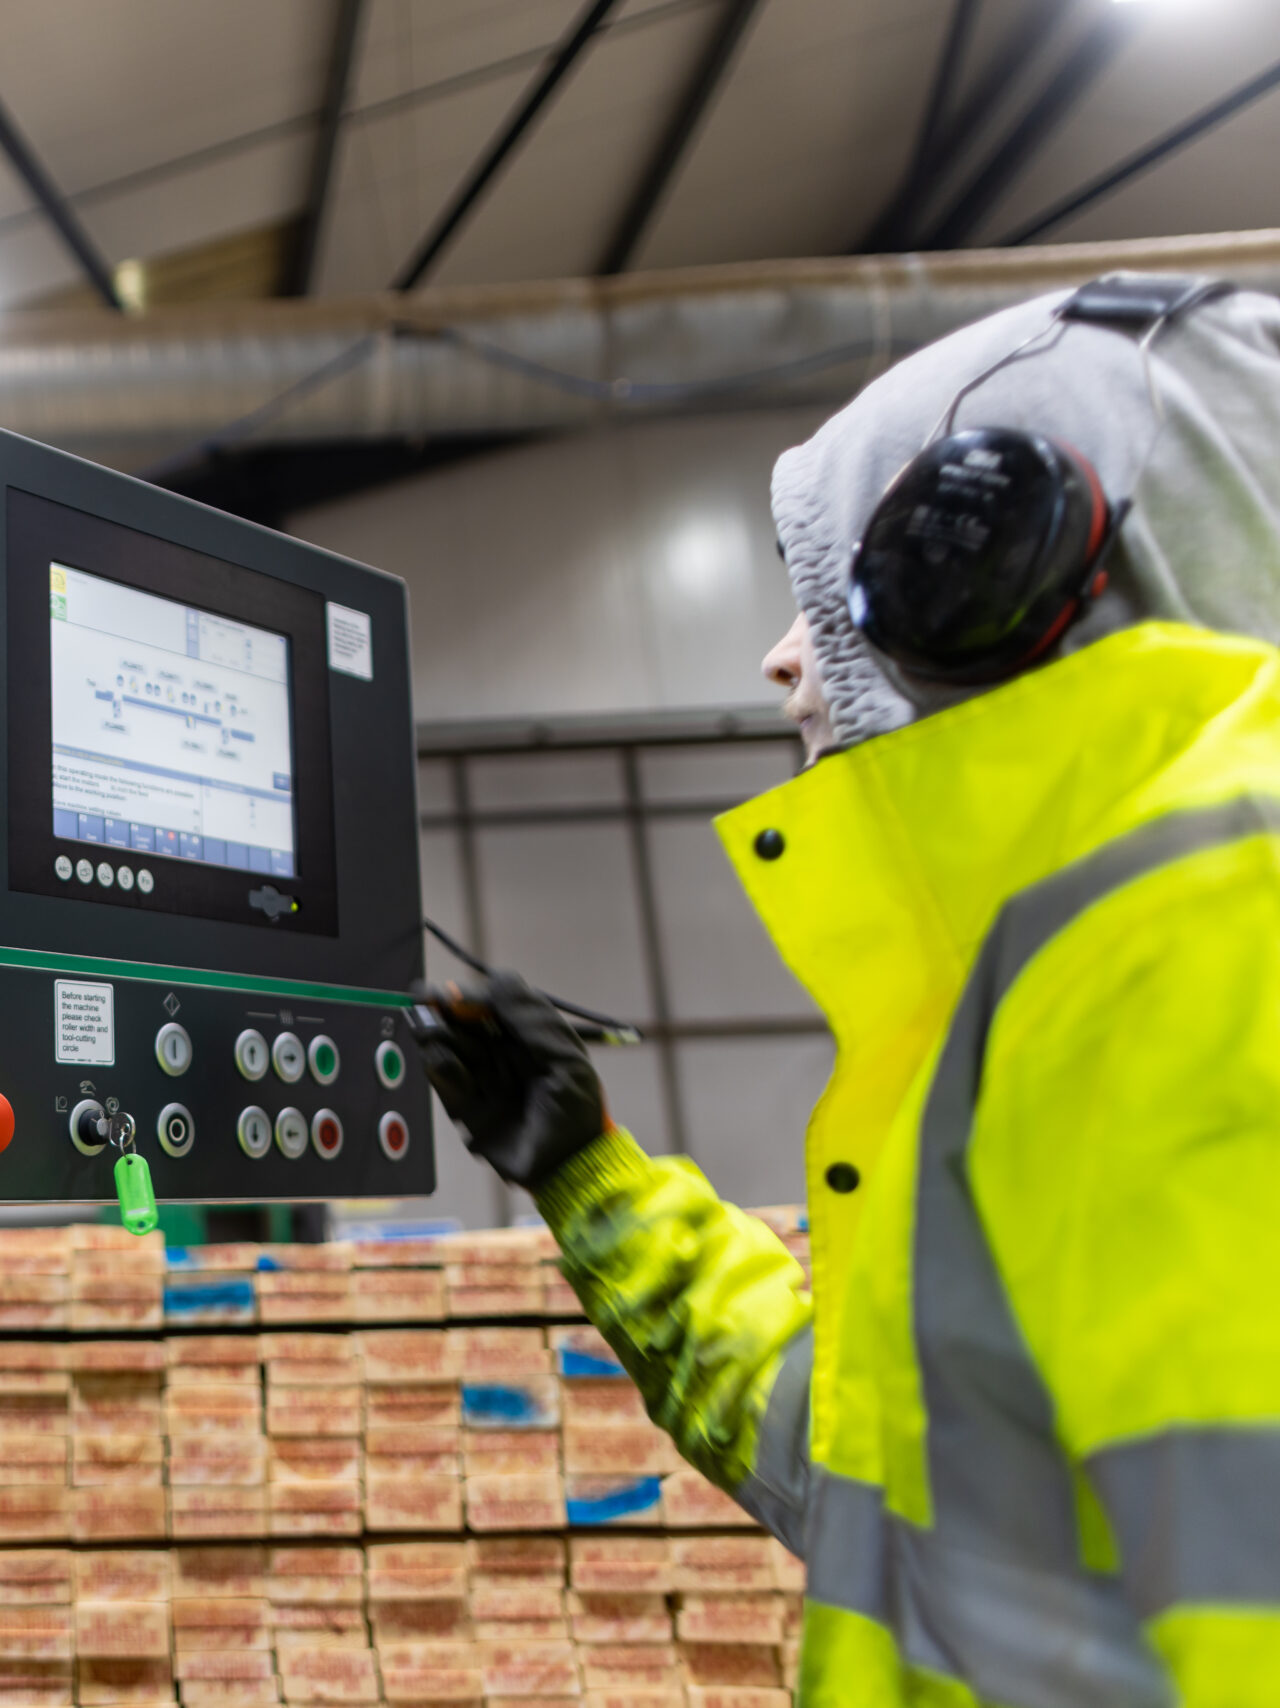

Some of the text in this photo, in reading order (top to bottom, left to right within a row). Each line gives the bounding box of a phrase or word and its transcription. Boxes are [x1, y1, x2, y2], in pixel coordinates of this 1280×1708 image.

[62, 991, 105, 1004] Before starting
[62, 1002, 99, 1012] the machine
[62, 1013, 102, 1022] please check
[62, 1023, 108, 1033] roller width and
[62, 1033, 96, 1044] tool-cutting
[62, 1044, 79, 1052] circle
